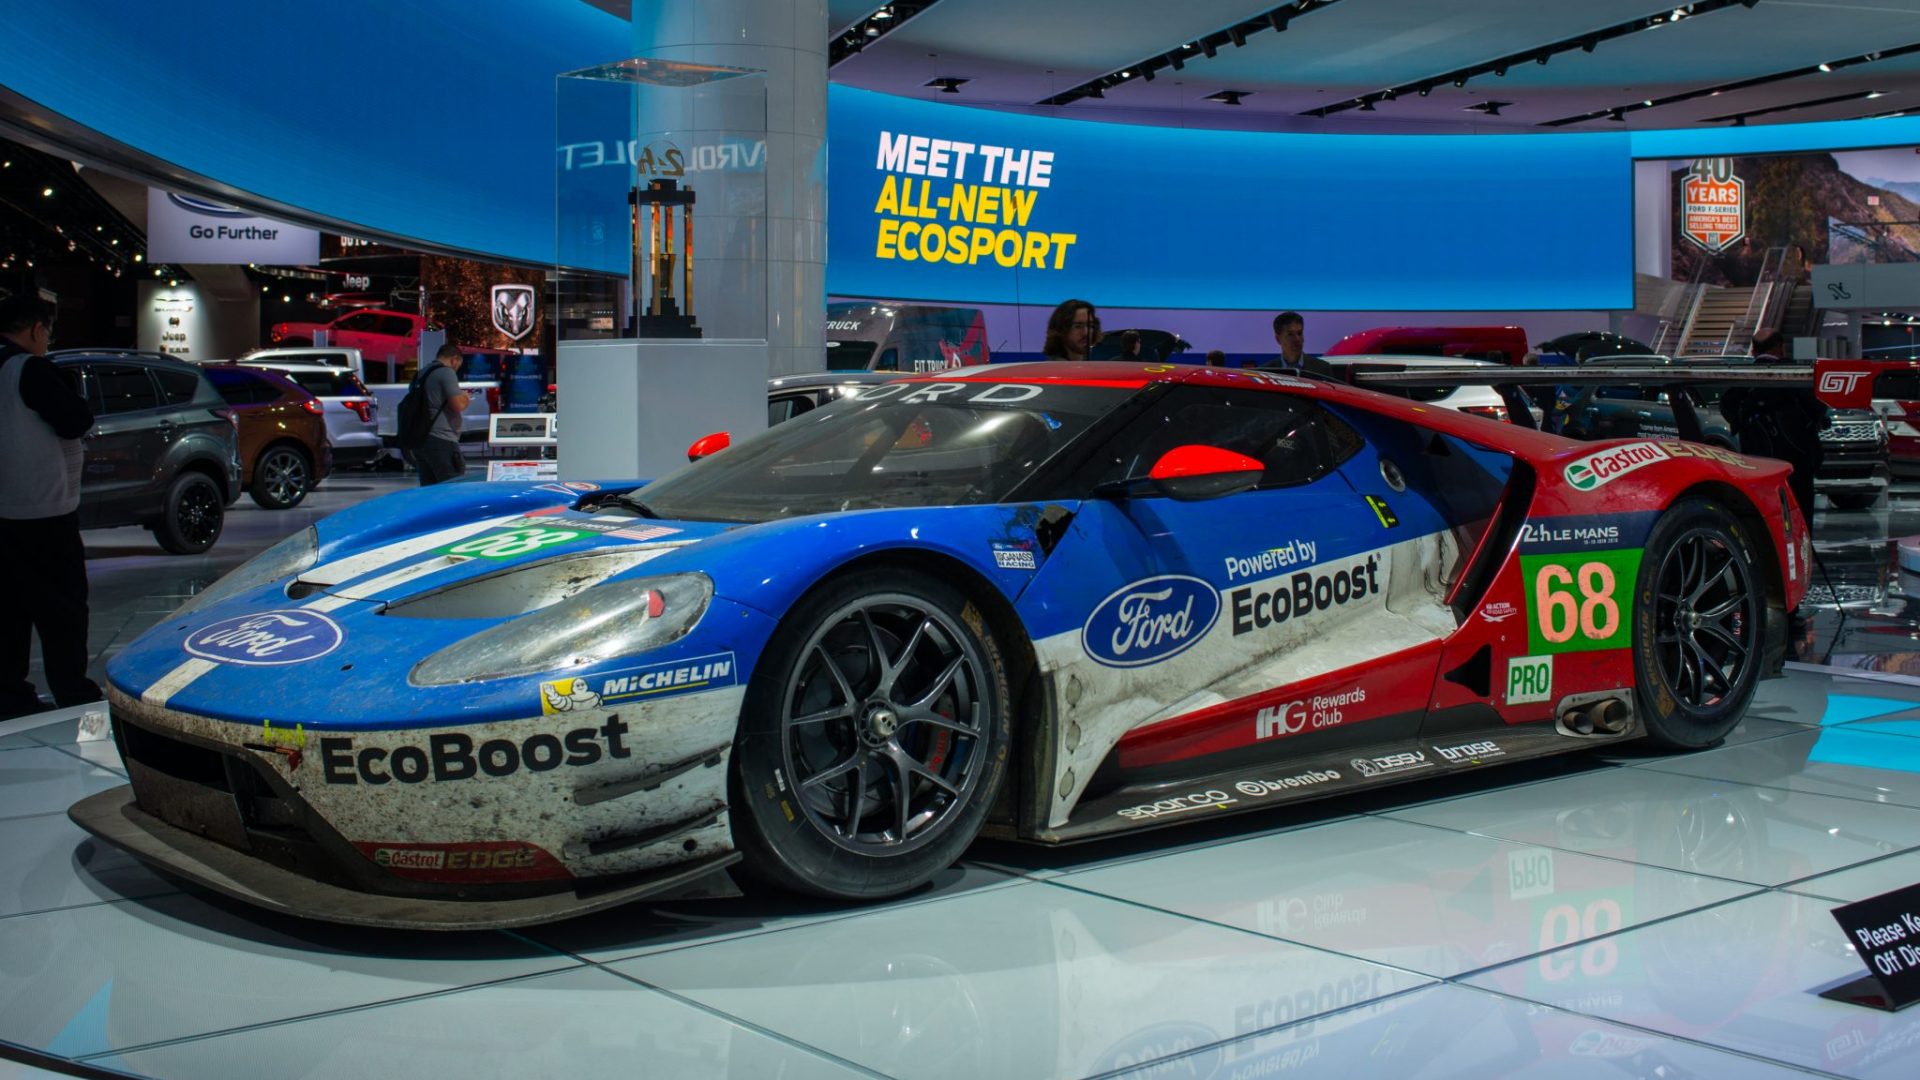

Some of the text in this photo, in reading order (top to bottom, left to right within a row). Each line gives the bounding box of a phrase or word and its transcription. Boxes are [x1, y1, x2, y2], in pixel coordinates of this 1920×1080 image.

[876, 131, 1054, 187] MEET THE
[1690, 158, 1733, 184] 40
[875, 175, 1038, 226] ALL-NEW
[1689, 187, 1737, 203] YEARS
[190, 225, 279, 241] Go Further
[876, 219, 1077, 269] ECOSPORT
[342, 273, 370, 291] Jeep
[1819, 371, 1872, 396] GT
[1590, 441, 1757, 478] Castrol EDGE
[450, 528, 579, 557] 68
[1553, 529, 1571, 541] LE
[1574, 526, 1619, 540] MANS
[999, 560, 1034, 568] RACING
[1225, 539, 1317, 581] Powered by
[1535, 561, 1621, 645] 68
[199, 614, 316, 657] Ford
[1111, 587, 1195, 656] Ford
[1510, 662, 1549, 697] PRO
[1256, 687, 1366, 740] IHG Rewards
[1312, 708, 1343, 728] Club
[321, 714, 631, 785] EcoBoost
[1372, 750, 1426, 769] DSSV
[1433, 740, 1500, 760] brose
[1259, 769, 1342, 792] brembo
[1117, 789, 1231, 818] sparco
[391, 850, 536, 869] Castrol EDGE
[1855, 922, 1907, 950] Please
[1874, 949, 1904, 976] Off
